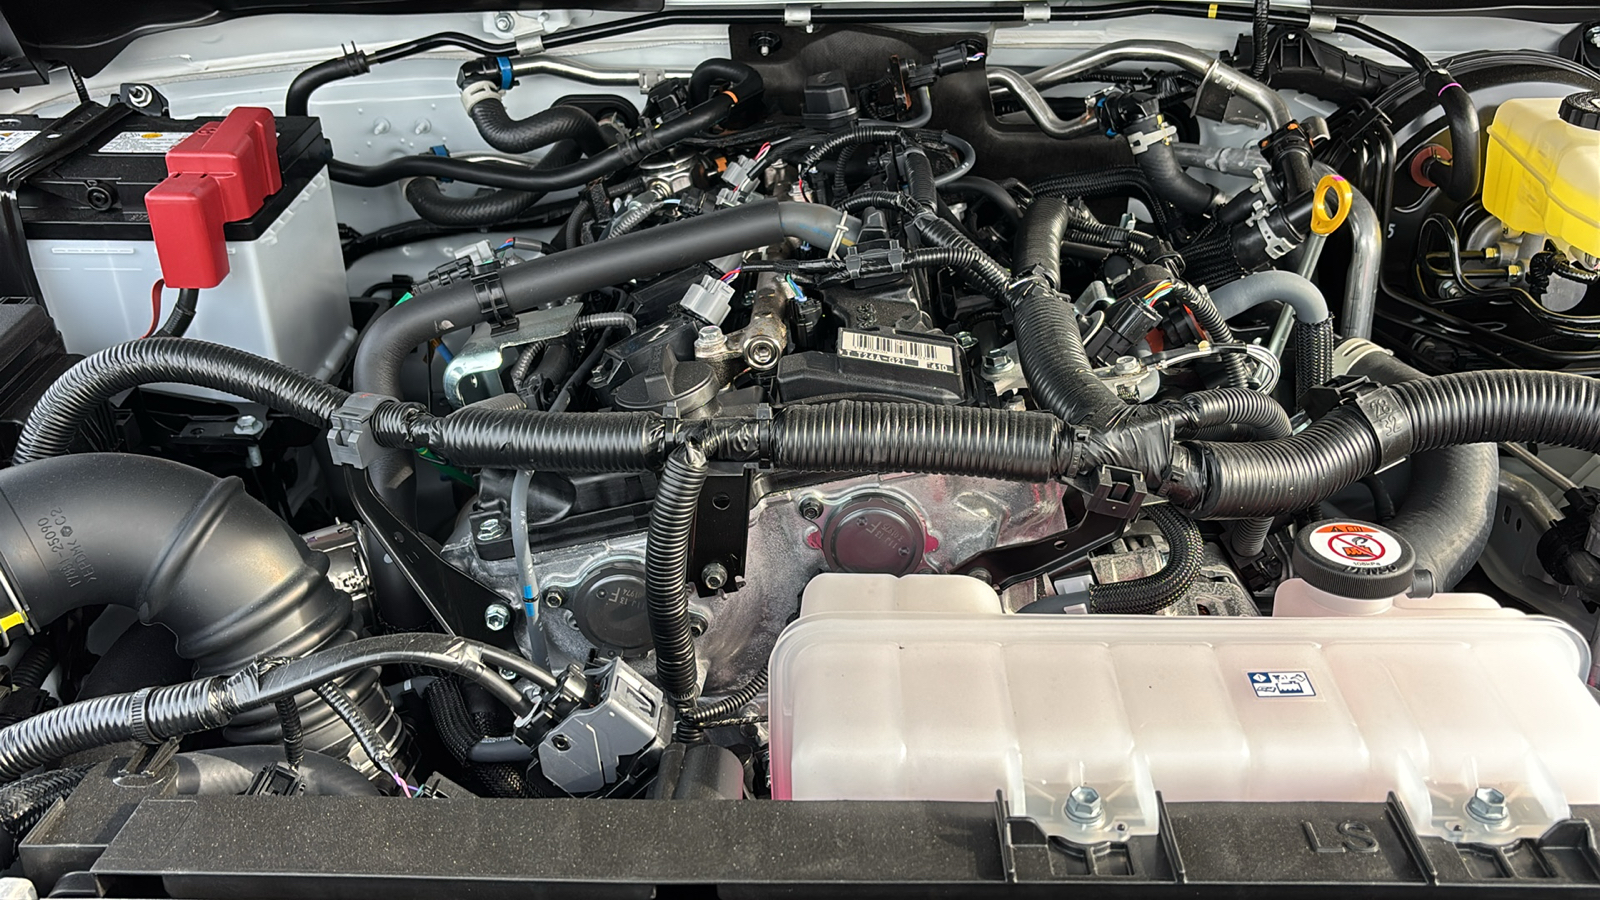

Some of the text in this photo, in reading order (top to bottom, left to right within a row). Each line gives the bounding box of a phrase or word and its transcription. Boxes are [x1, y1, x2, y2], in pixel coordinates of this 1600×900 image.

[1387, 223, 1396, 239] 5
[1370, 399, 1393, 418] 28
[1384, 415, 1403, 437] 32
[865, 521, 882, 534] F
[37, 517, 81, 588] 17881-25090
[608, 587, 620, 602] F
[1301, 820, 1380, 853] LS
